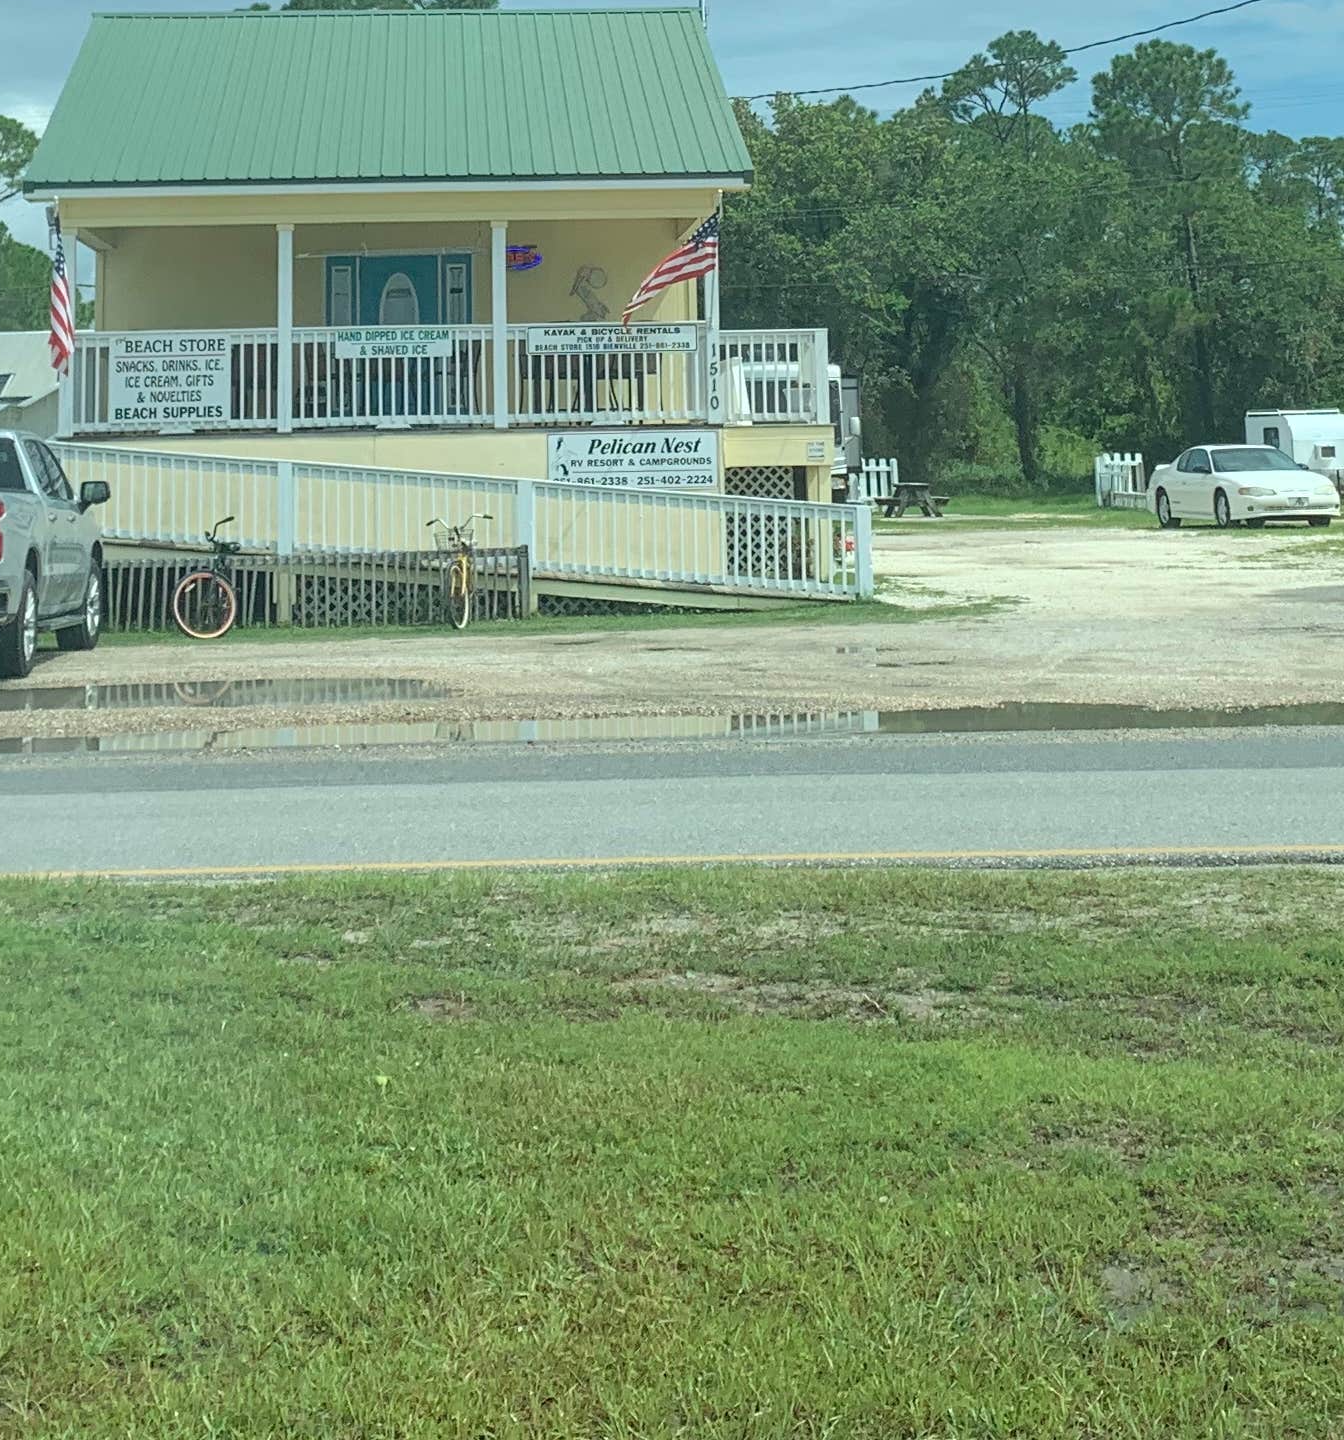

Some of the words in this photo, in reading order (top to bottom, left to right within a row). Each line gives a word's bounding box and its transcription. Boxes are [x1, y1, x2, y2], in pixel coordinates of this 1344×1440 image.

[338, 331, 362, 341] HAND
[365, 331, 397, 341] DIPPED
[400, 330, 415, 340] ICE
[418, 330, 449, 340] CREAM
[636, 327, 681, 335] RENTALS
[125, 340, 173, 353] BEACH
[179, 339, 226, 352] STORE
[359, 345, 368, 355] &
[371, 345, 408, 355] SHAVED
[412, 345, 428, 355] ICE
[125, 376, 141, 388] ICE
[186, 375, 214, 387] GIFTS
[137, 392, 146, 404] &
[150, 391, 202, 402] NOVELTIES
[115, 407, 157, 419] BEACH
[163, 406, 223, 418] SUPPLIES
[587, 438, 656, 455] Pelican
[661, 437, 702, 454] Nest
[587, 459, 624, 467] RESORT
[639, 457, 712, 466] CAMPGROUNDS
[637, 475, 713, 485] 251-402-2224
